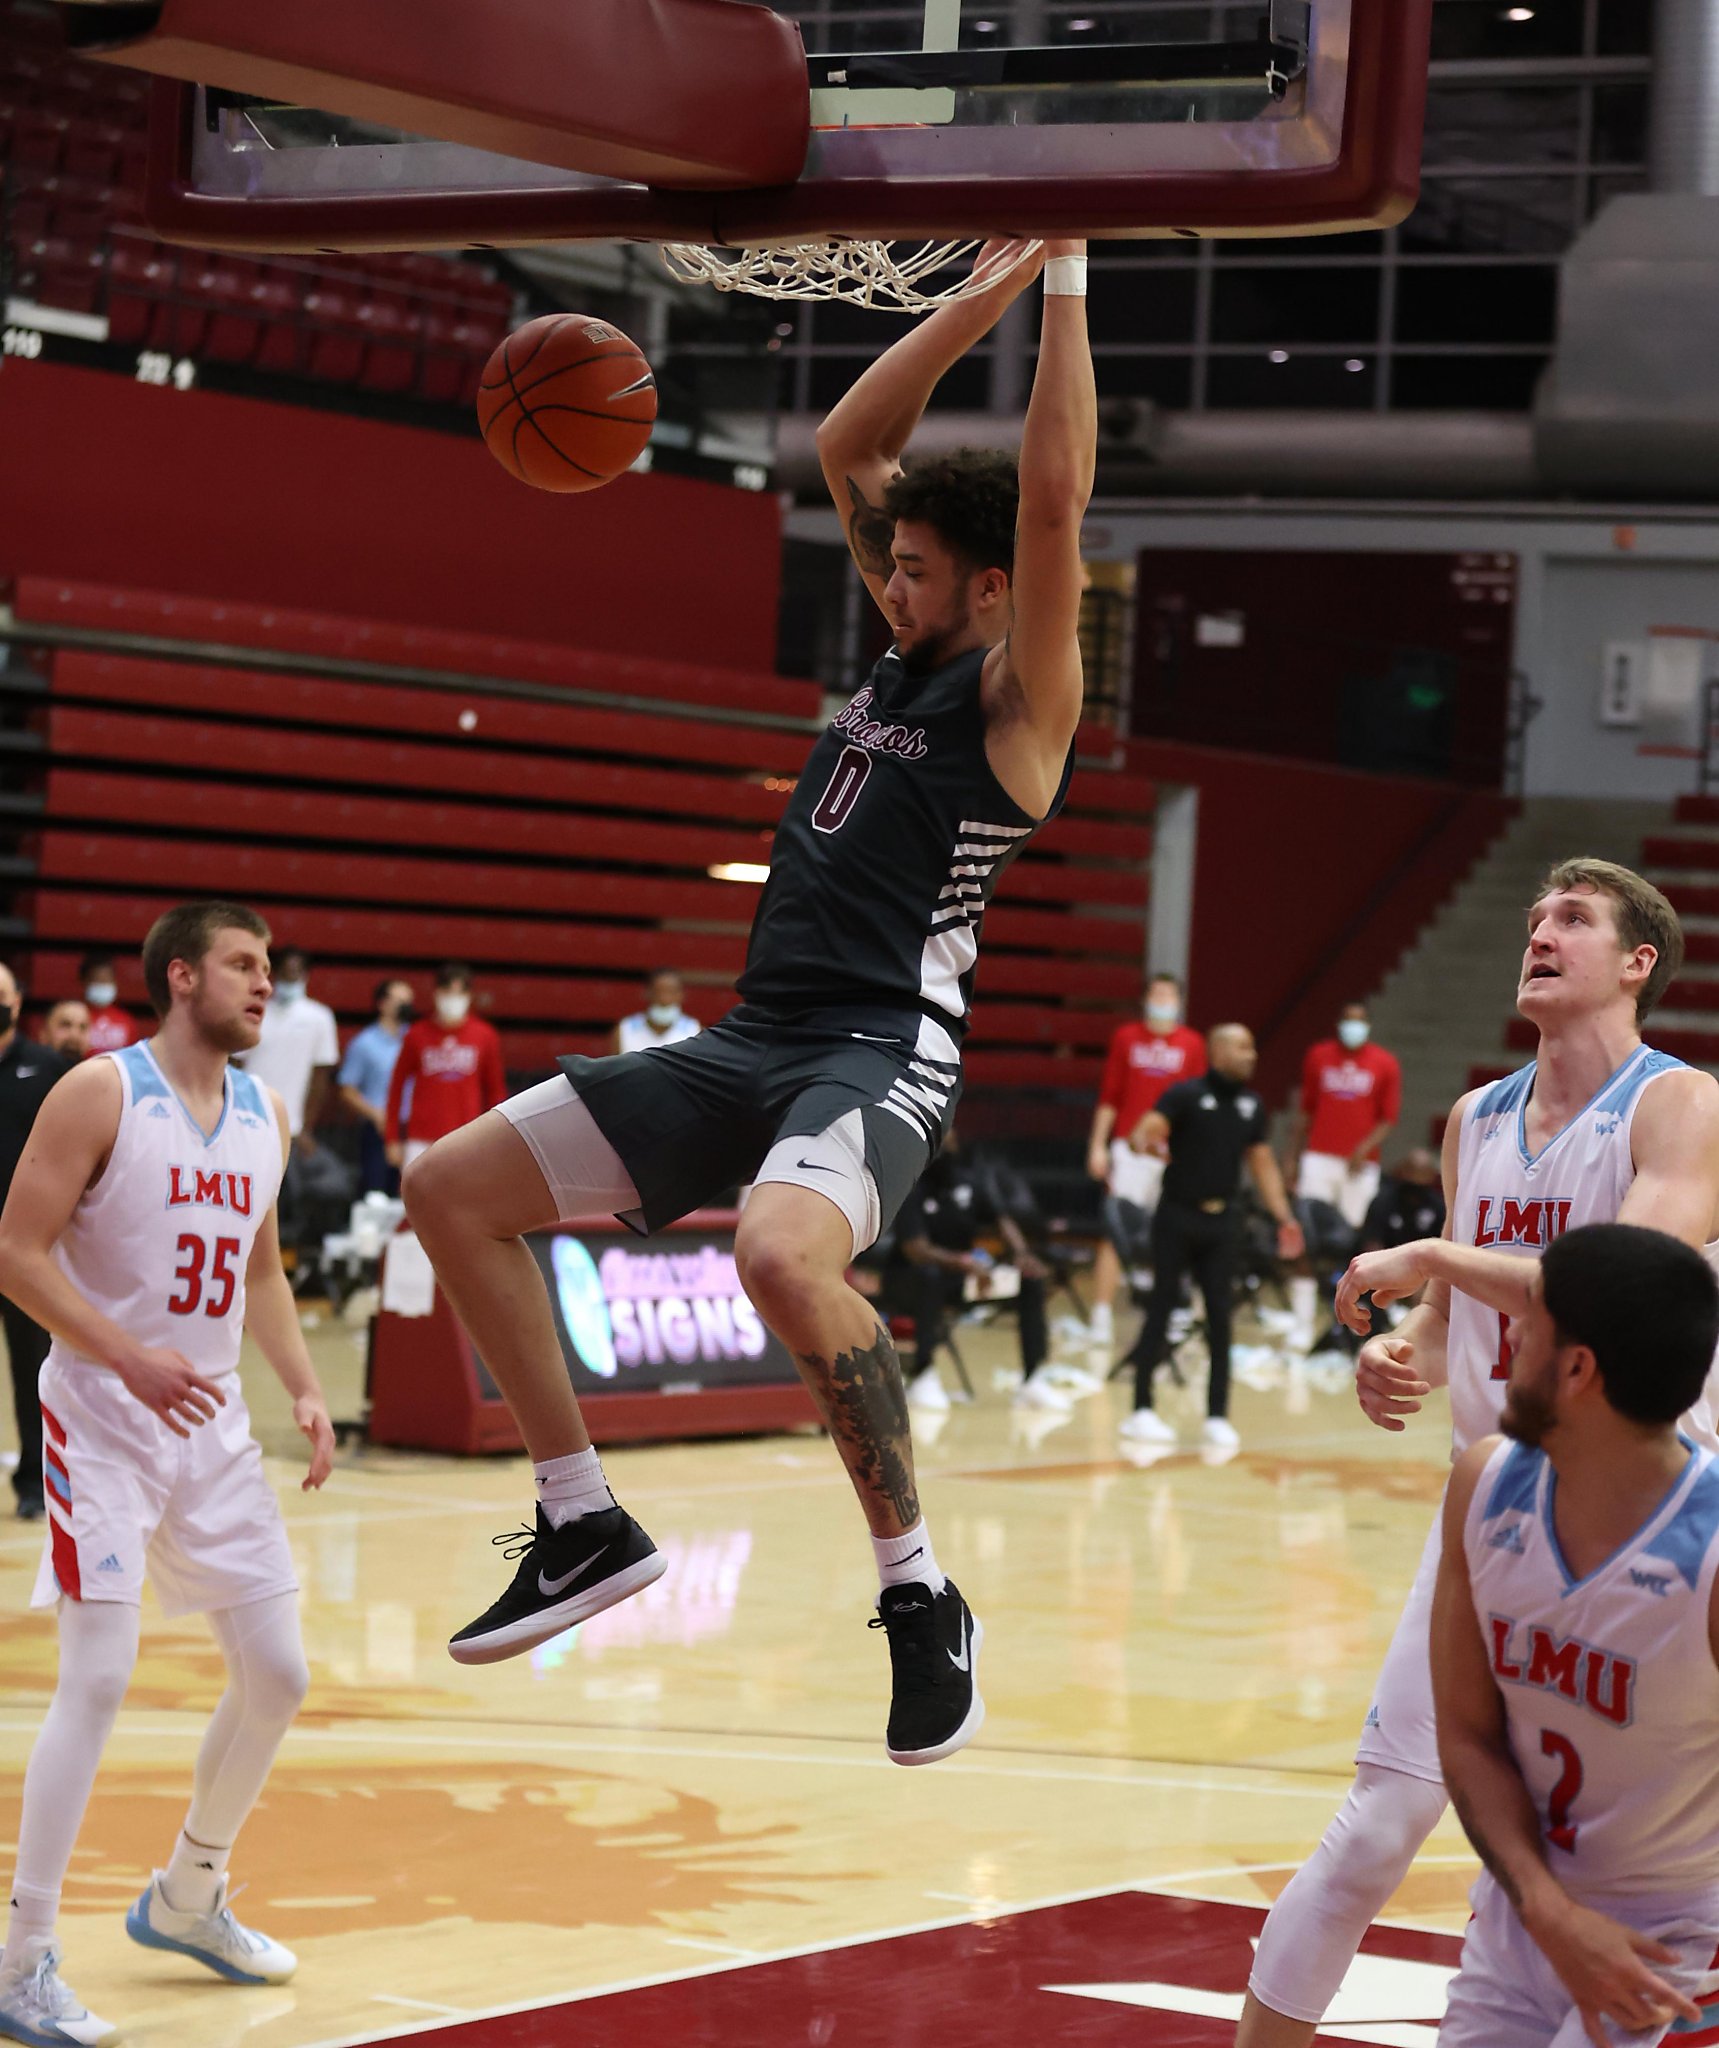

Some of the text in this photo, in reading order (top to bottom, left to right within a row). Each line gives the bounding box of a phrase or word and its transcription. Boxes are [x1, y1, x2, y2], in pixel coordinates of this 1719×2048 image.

[812, 745, 872, 834] 0
[166, 1164, 254, 1220] LMU
[1473, 1196, 1574, 1249] LMU
[167, 1233, 240, 1317] 35
[609, 1296, 767, 1367] SIGNS
[1488, 1612, 1637, 1729] LMU
[1540, 1728, 1584, 1855] 2
